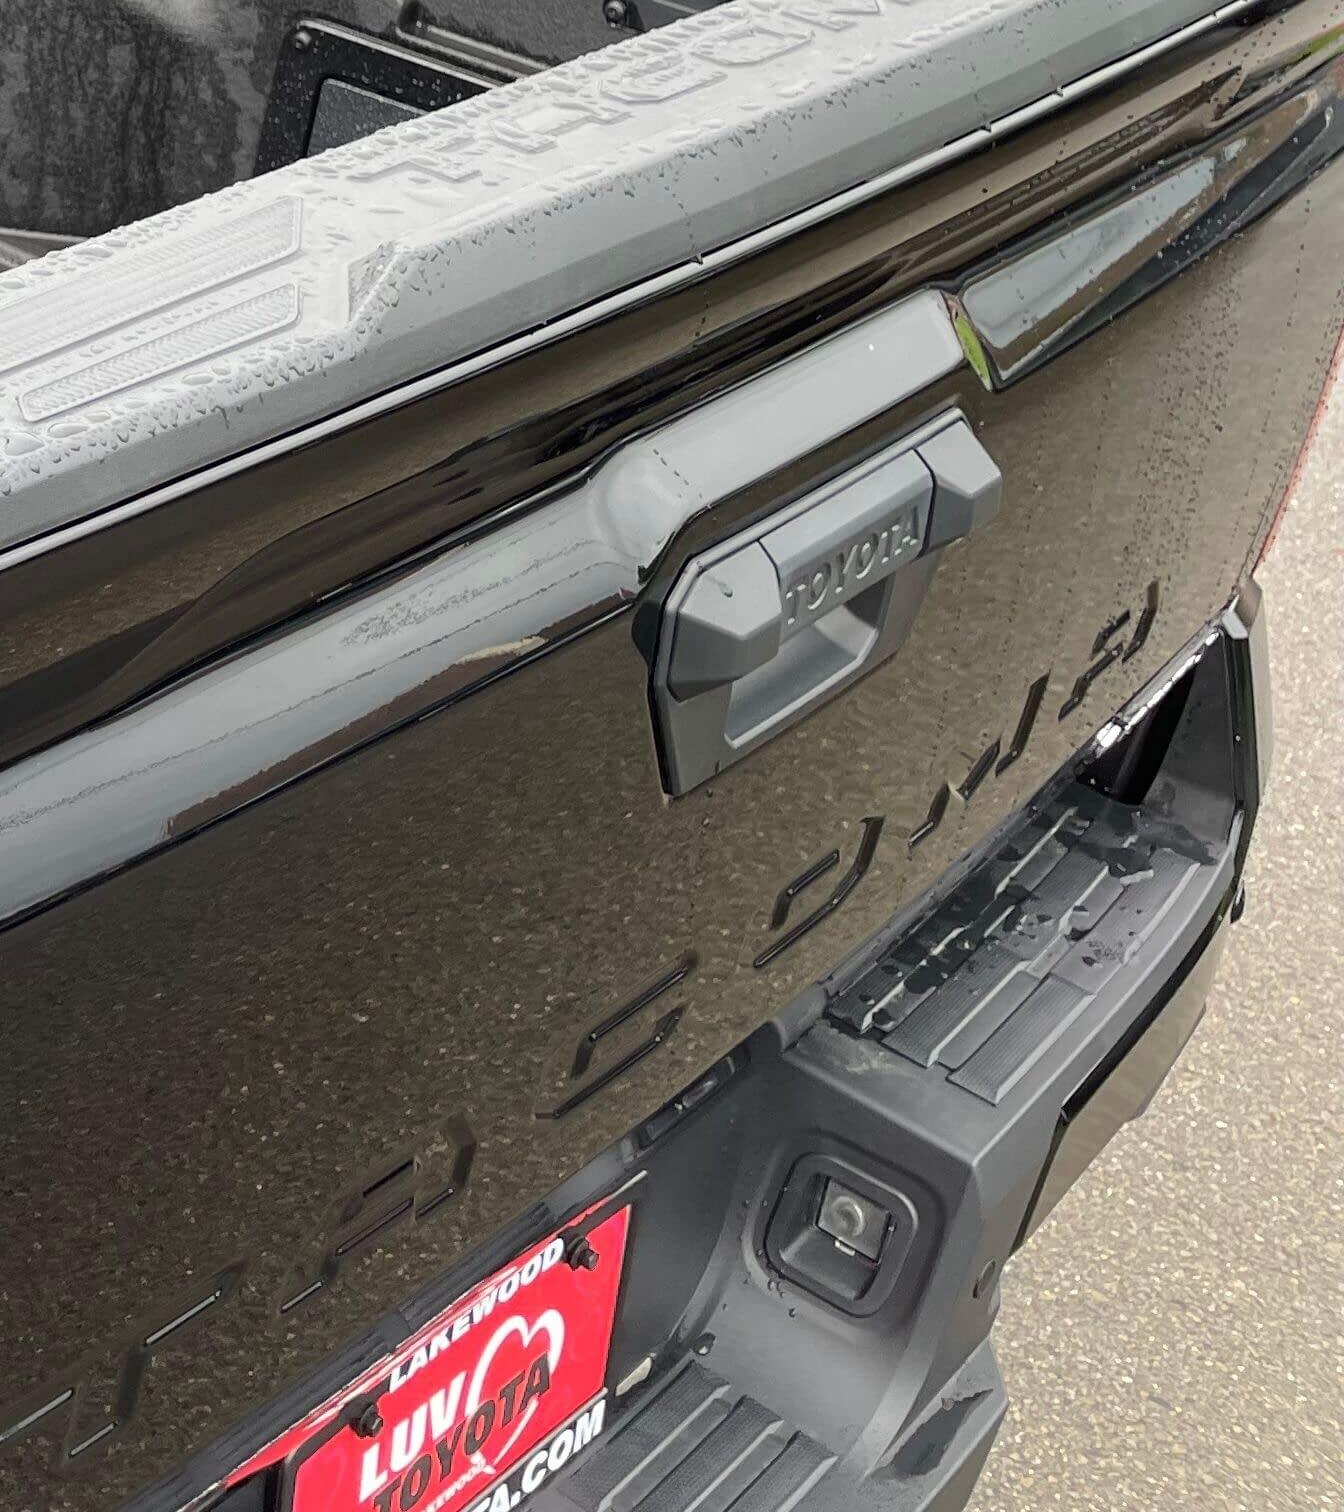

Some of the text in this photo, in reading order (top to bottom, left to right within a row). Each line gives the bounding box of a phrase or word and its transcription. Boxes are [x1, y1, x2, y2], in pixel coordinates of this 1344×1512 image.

[785, 505, 920, 625] TOYOTA
[388, 1237, 566, 1393] LAKEWOOD
[358, 1370, 466, 1504] LUV
[373, 1353, 552, 1512] TOYOTA
